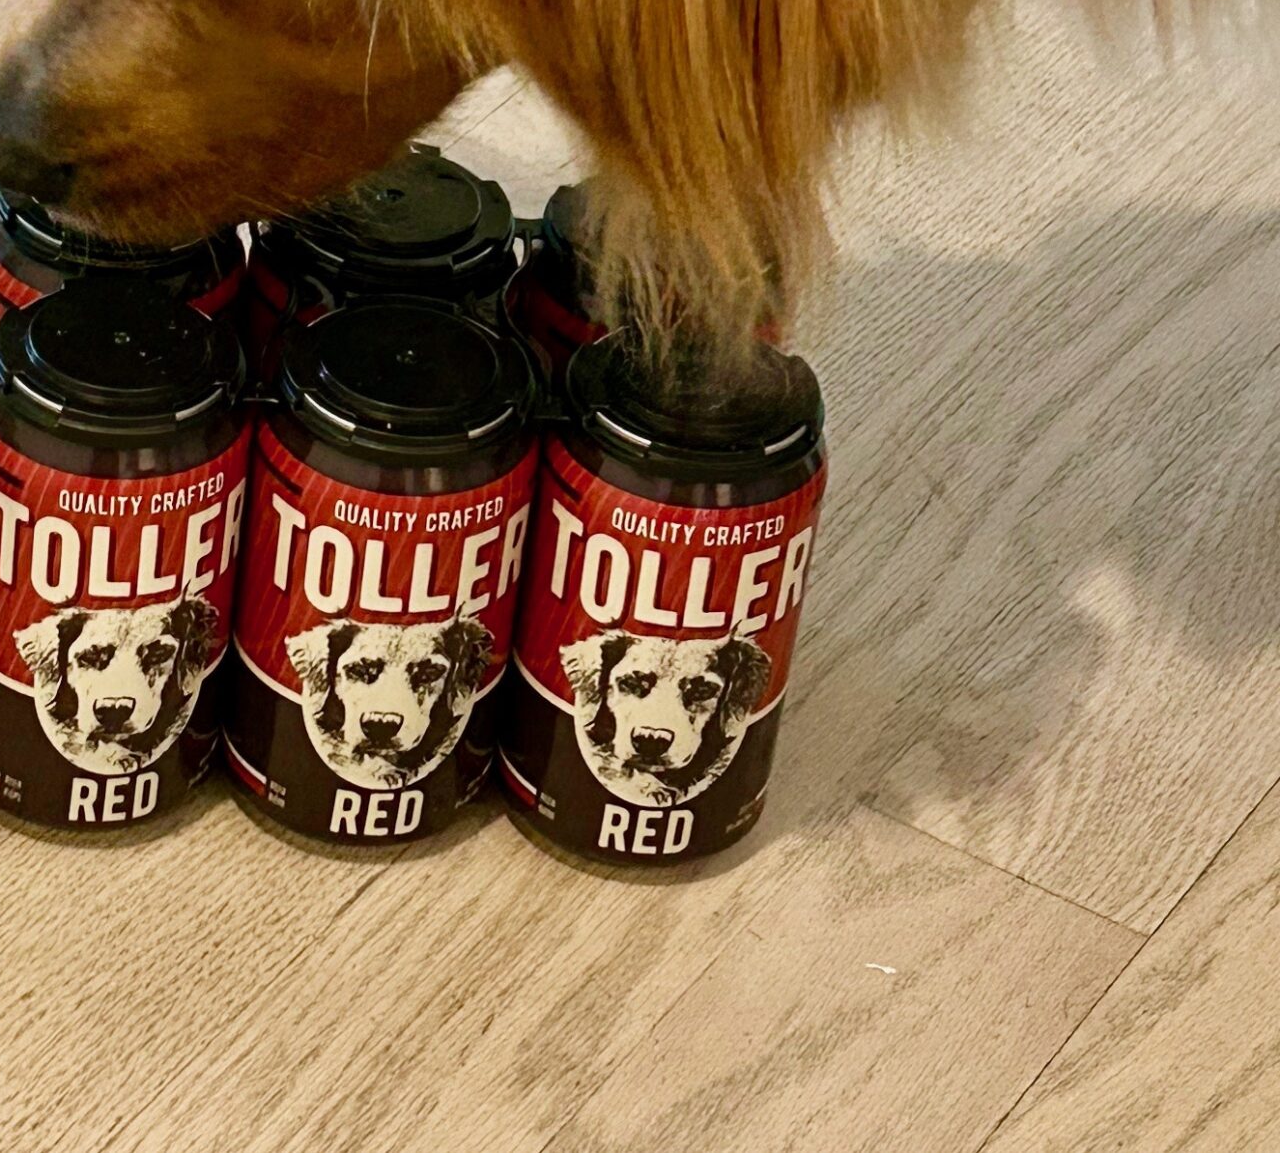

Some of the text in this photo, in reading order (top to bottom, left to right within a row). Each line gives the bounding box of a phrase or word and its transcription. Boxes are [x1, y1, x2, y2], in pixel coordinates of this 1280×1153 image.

[59, 472, 224, 517] QUALITY CRAFTED
[334, 496, 504, 533] QUALITY CRAFTED
[611, 507, 785, 547] QUALITY CRAFTED
[272, 493, 530, 614] TOLLER
[551, 498, 812, 637] TOLLER
[68, 771, 159, 822] RED
[330, 789, 424, 836] RED
[598, 803, 695, 855] RED
